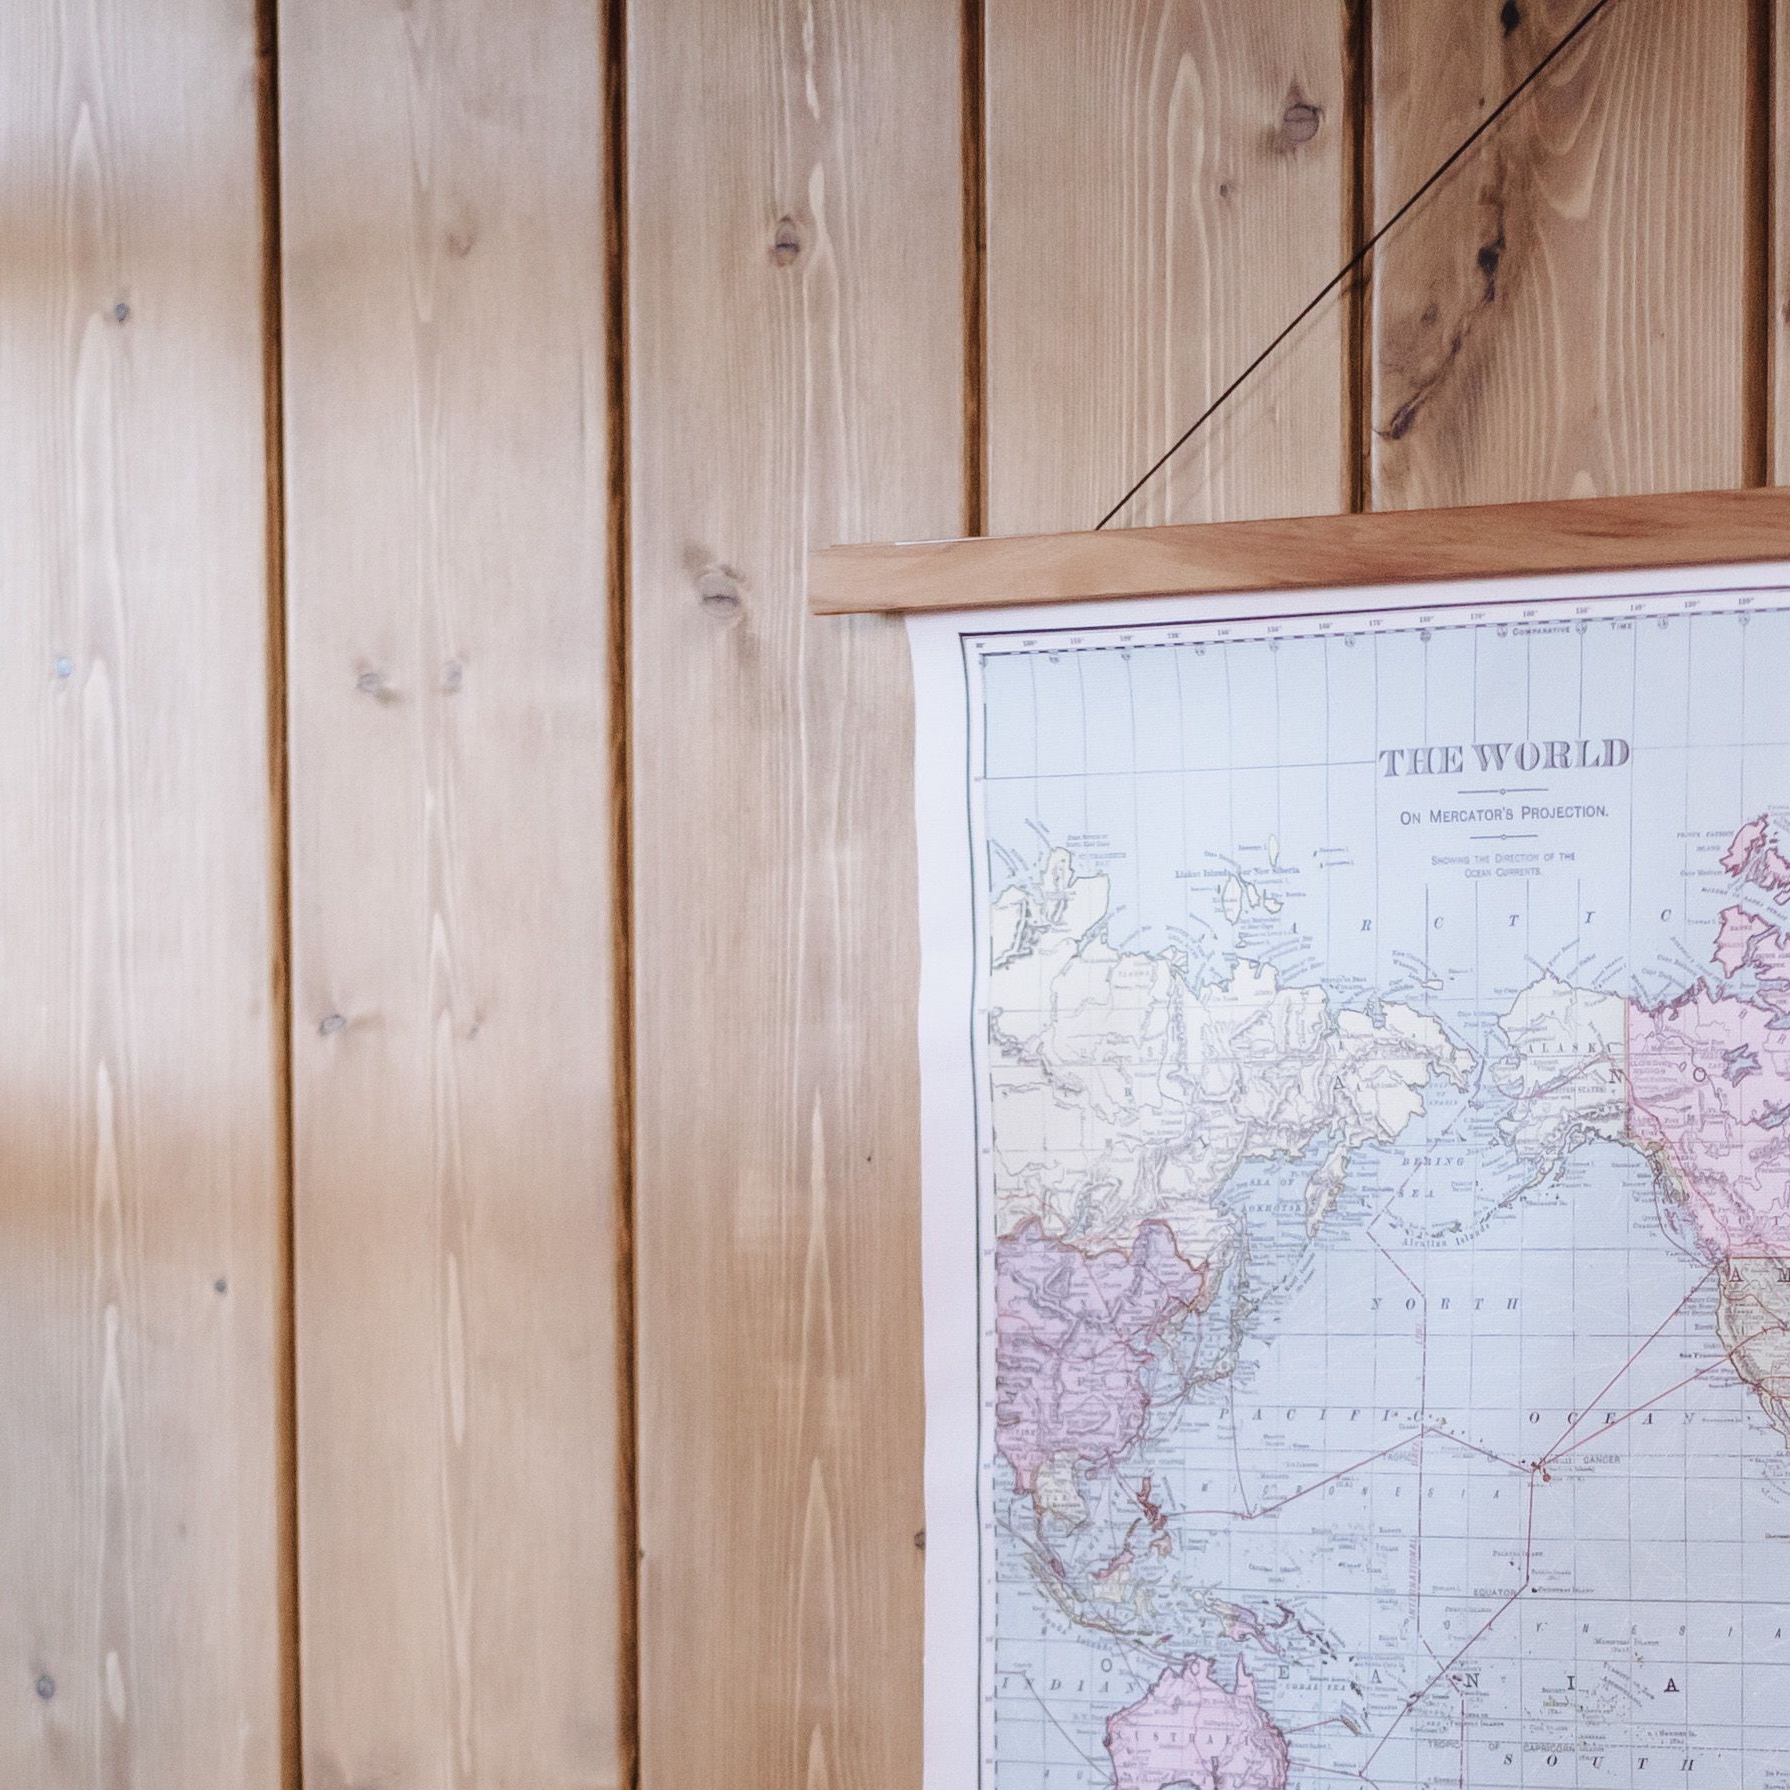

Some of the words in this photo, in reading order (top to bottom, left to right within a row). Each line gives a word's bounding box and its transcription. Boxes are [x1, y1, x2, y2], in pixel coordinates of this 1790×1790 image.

[1378, 745, 1464, 778] THE
[1471, 738, 1630, 772] WORLD
[1400, 810, 1421, 825] ON
[1429, 807, 1514, 824] MERCATOR'S
[1521, 805, 1609, 820] PROJECTION.
[1431, 853, 1470, 866] SHOWING
[1475, 854, 1490, 864] THE
[1494, 853, 1540, 864] DIRECTION
[1543, 852, 1555, 862] OF
[1559, 851, 1575, 861] THE
[1464, 868, 1492, 878] OCEAN
[1370, 1297, 1522, 1311] NORTH
[1529, 1411, 1696, 1426] OCEAN
[1583, 1455, 1621, 1465] CANCER
[1473, 1587, 1517, 1597] EQUATOR
[1428, 1740, 1461, 1750] TROPIC
[1502, 1753, 1695, 1772] SOUTH
